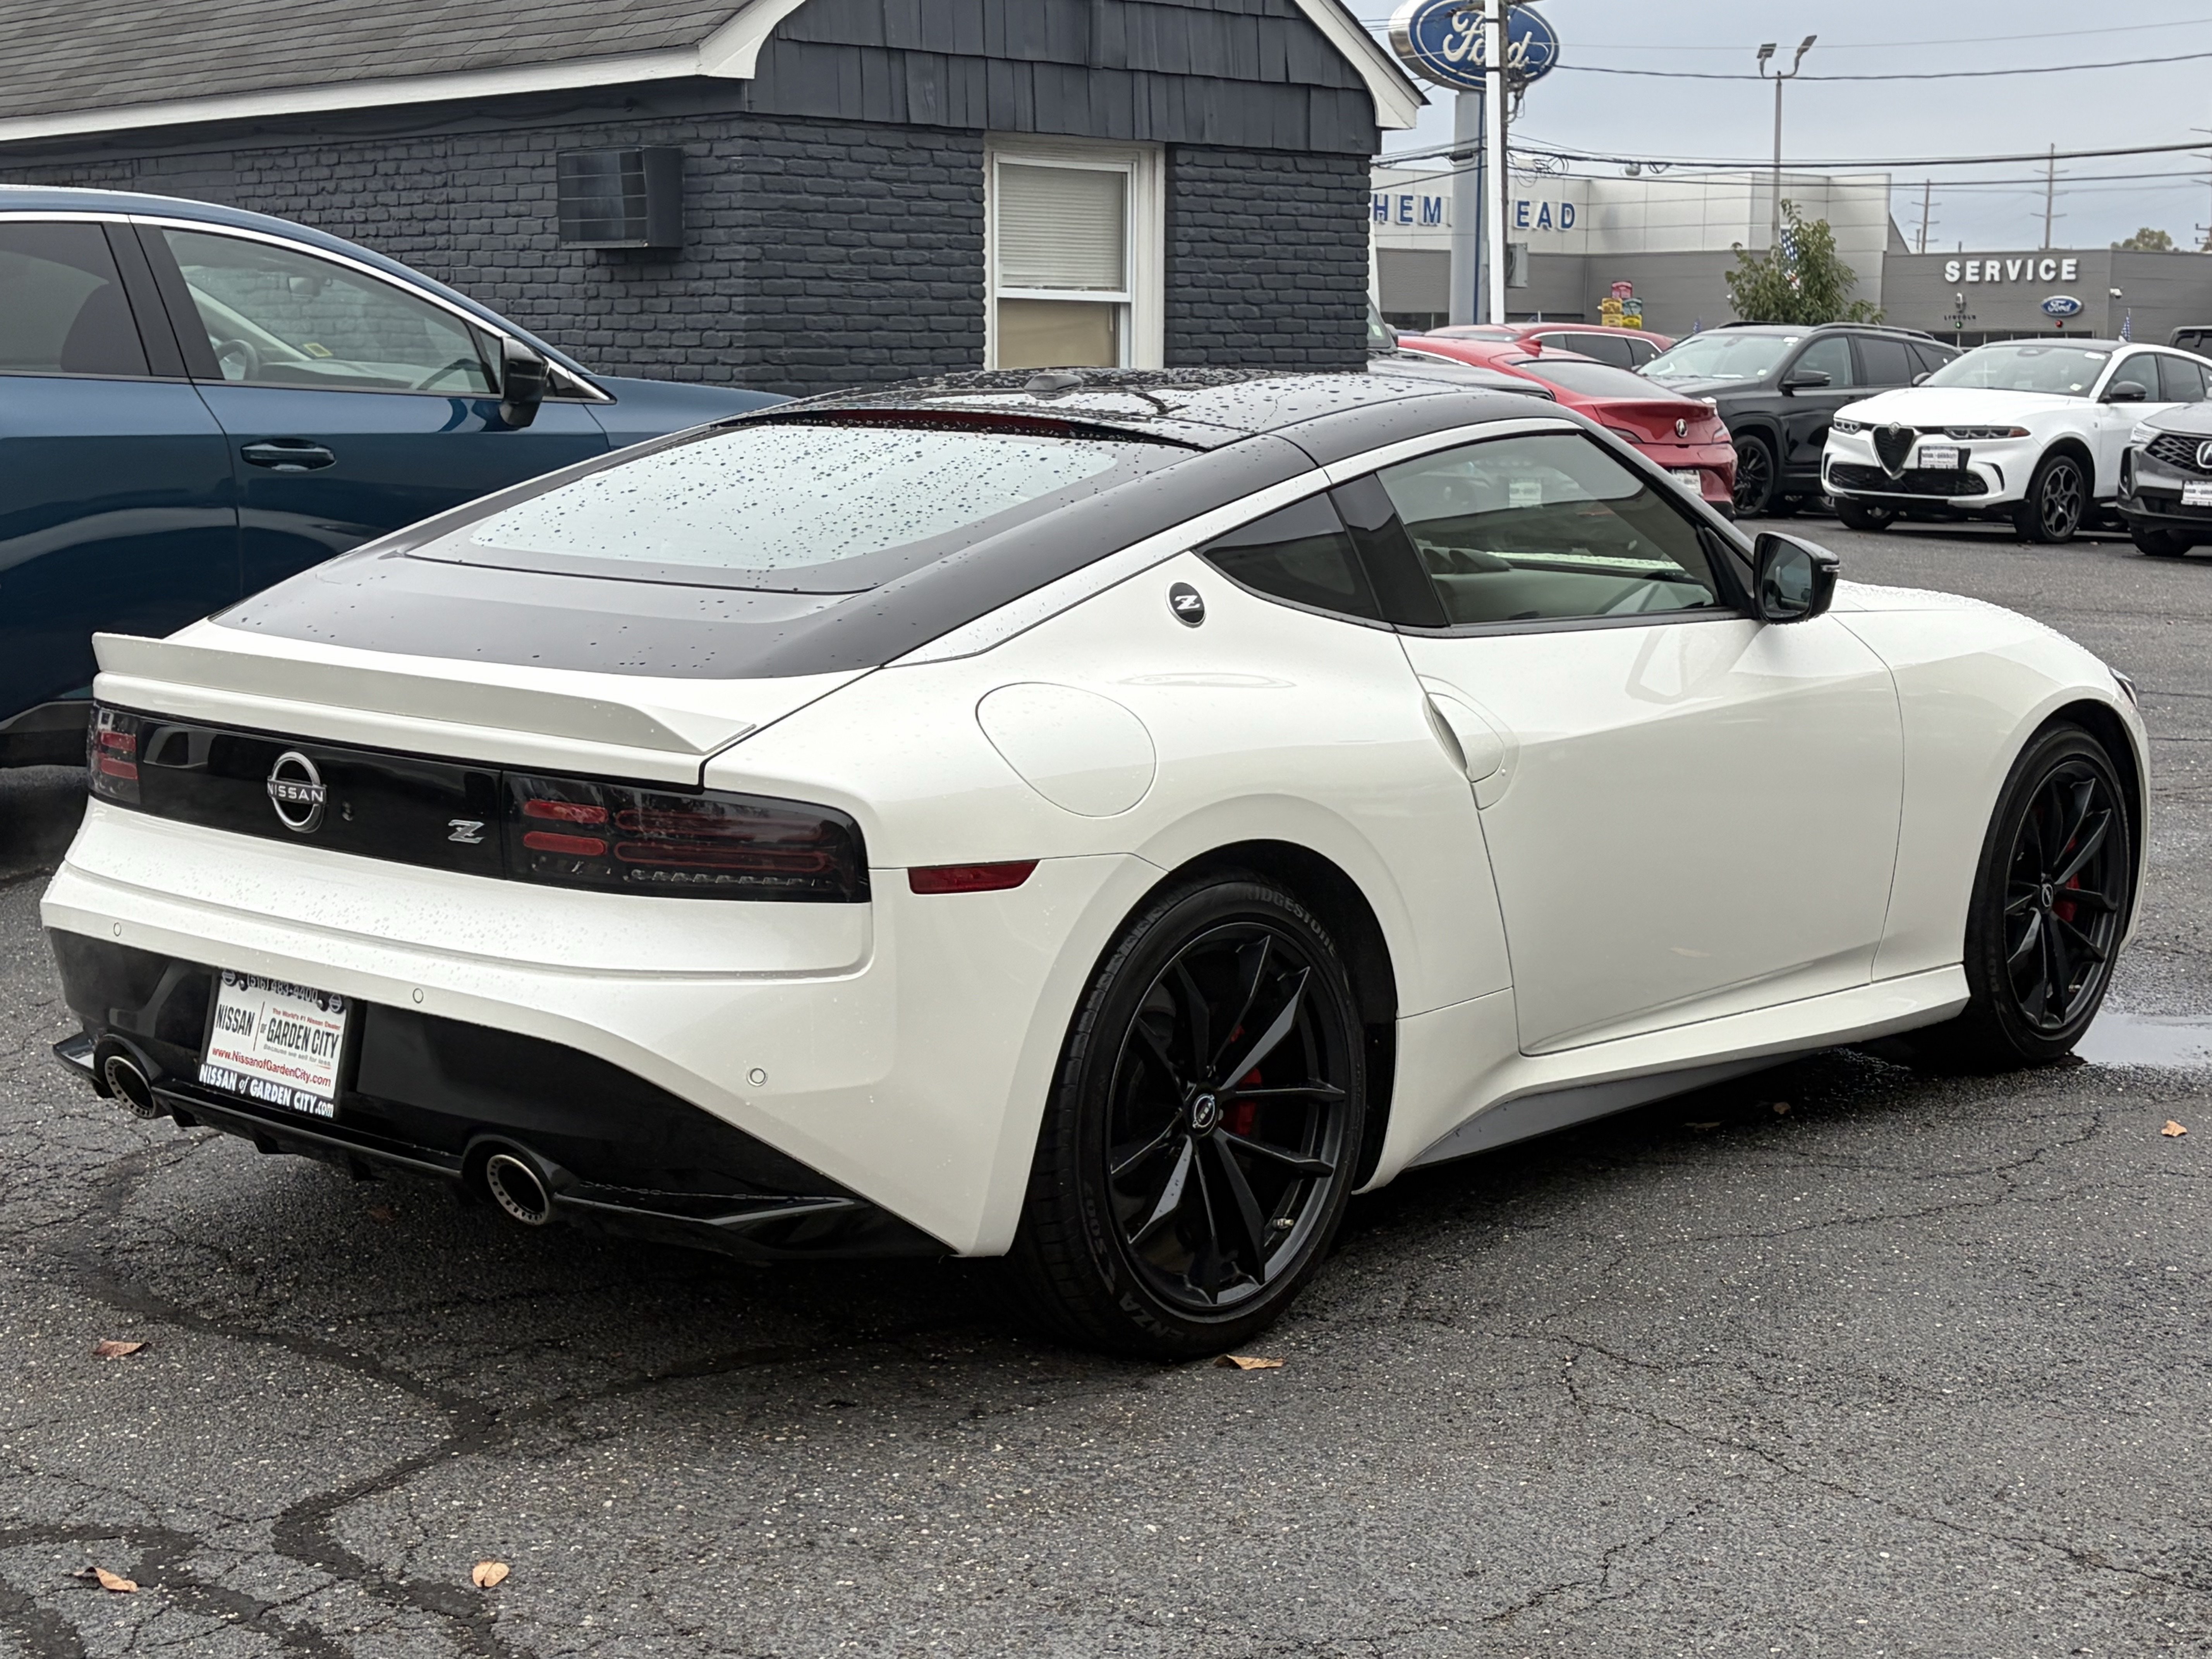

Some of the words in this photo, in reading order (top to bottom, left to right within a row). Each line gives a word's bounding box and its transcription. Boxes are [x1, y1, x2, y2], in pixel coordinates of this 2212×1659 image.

[1443, 10, 1548, 67] Fod
[1374, 193, 1575, 229] HEMEAD
[1944, 258, 2077, 282] SERVICE
[2047, 300, 2072, 313] Ford
[1175, 595, 1200, 610] Z
[267, 782, 323, 802] NISSAN
[448, 819, 486, 844] Z
[216, 1004, 255, 1036] NISSAN
[266, 1017, 312, 1051] GARDEN
[311, 1029, 340, 1058] CITY
[212, 1047, 331, 1087] www.NissanofGardenCity.com
[199, 1064, 237, 1091] NISSAN
[239, 1076, 250, 1094] of
[250, 1079, 292, 1106] GARDEN
